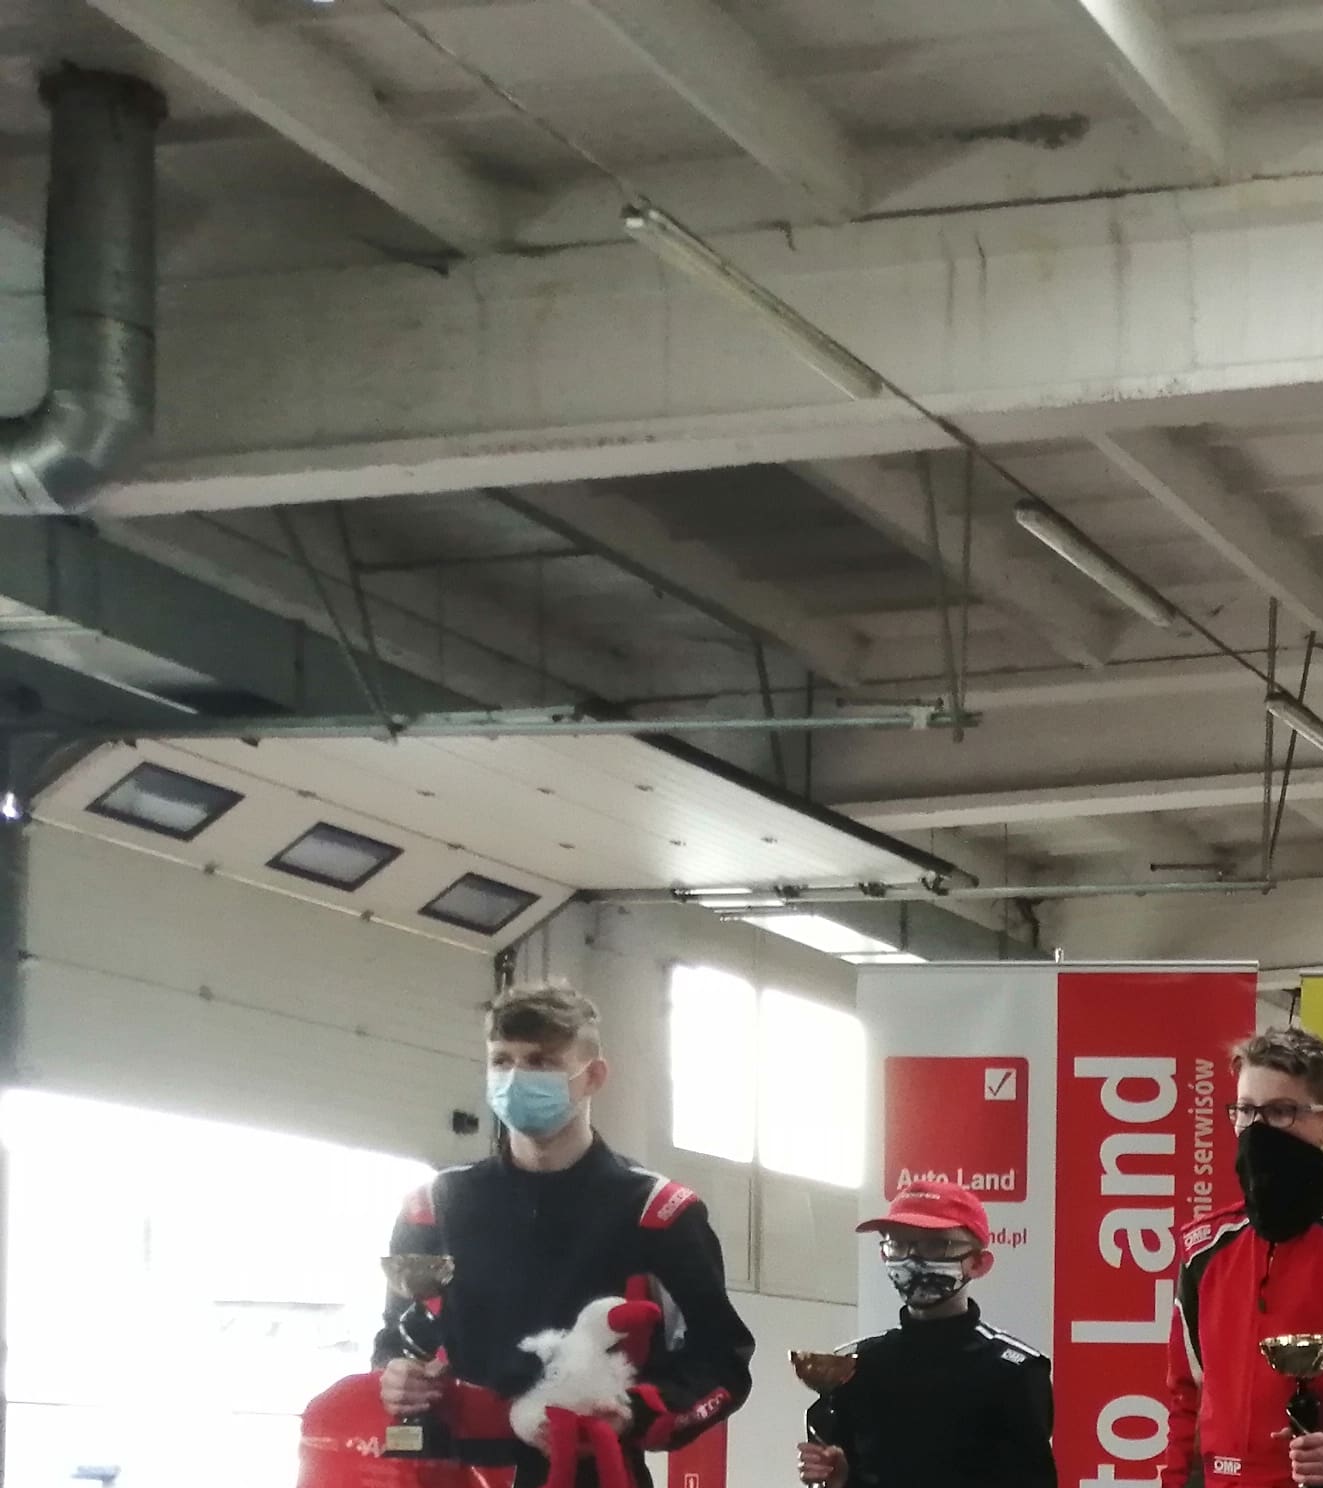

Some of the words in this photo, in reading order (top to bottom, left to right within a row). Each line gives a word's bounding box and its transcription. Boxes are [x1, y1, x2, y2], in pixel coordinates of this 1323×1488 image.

[1186, 1058, 1215, 1176] serwisów
[957, 1167, 1015, 1191] Land
[1071, 1056, 1178, 1345] Land
[1213, 1459, 1242, 1474] OMP
